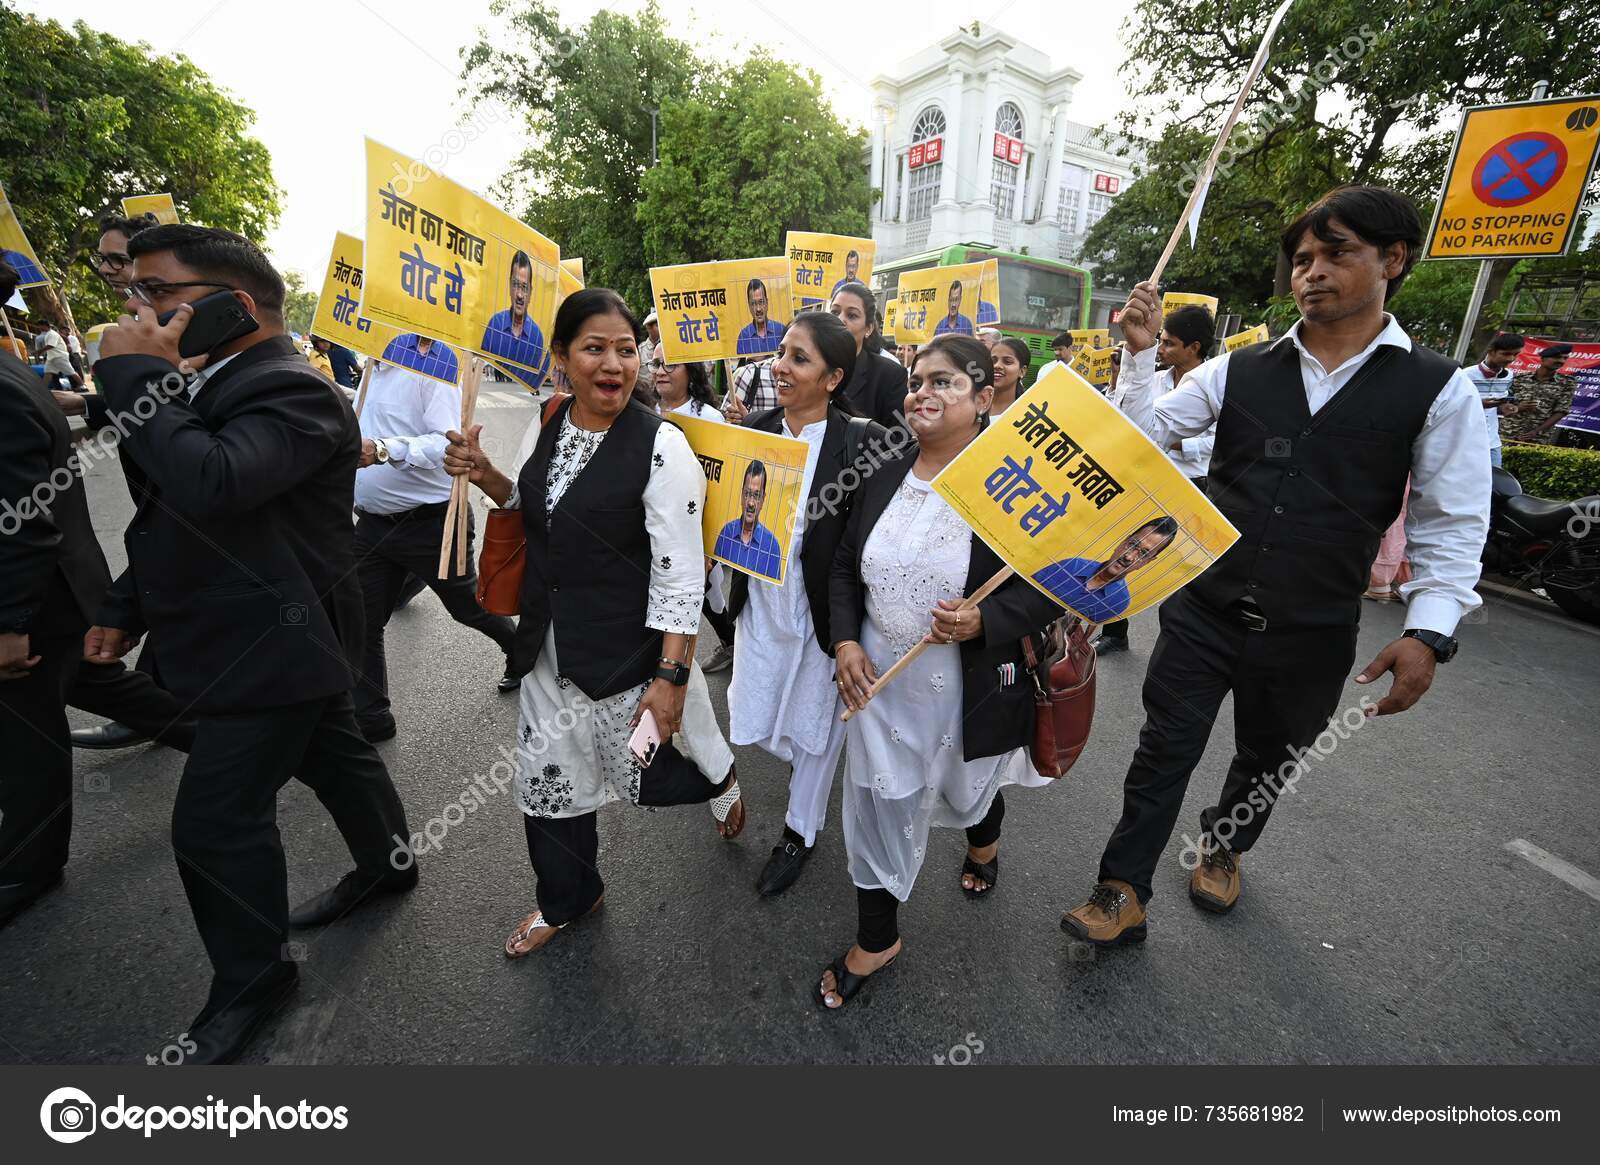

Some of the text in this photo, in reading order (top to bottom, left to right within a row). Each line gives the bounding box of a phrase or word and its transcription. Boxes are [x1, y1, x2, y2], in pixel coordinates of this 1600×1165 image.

[378, 182, 486, 266] जेल का जवाब
[1441, 212, 1566, 231] NO STOPPING
[1441, 231, 1554, 248] NO PARKING
[789, 245, 833, 264] जेल का जवाब
[333, 256, 353, 284] जेल
[400, 243, 465, 315] वोट से
[796, 263, 824, 286] वोट से
[333, 289, 359, 326] वोट
[660, 288, 727, 311] जेल का जवाब
[919, 288, 937, 302] जवाब
[676, 311, 719, 344] वोट से
[1012, 401, 1125, 510] जेल का जवाब
[983, 455, 1041, 515] वोट
[1019, 491, 1071, 538] से
